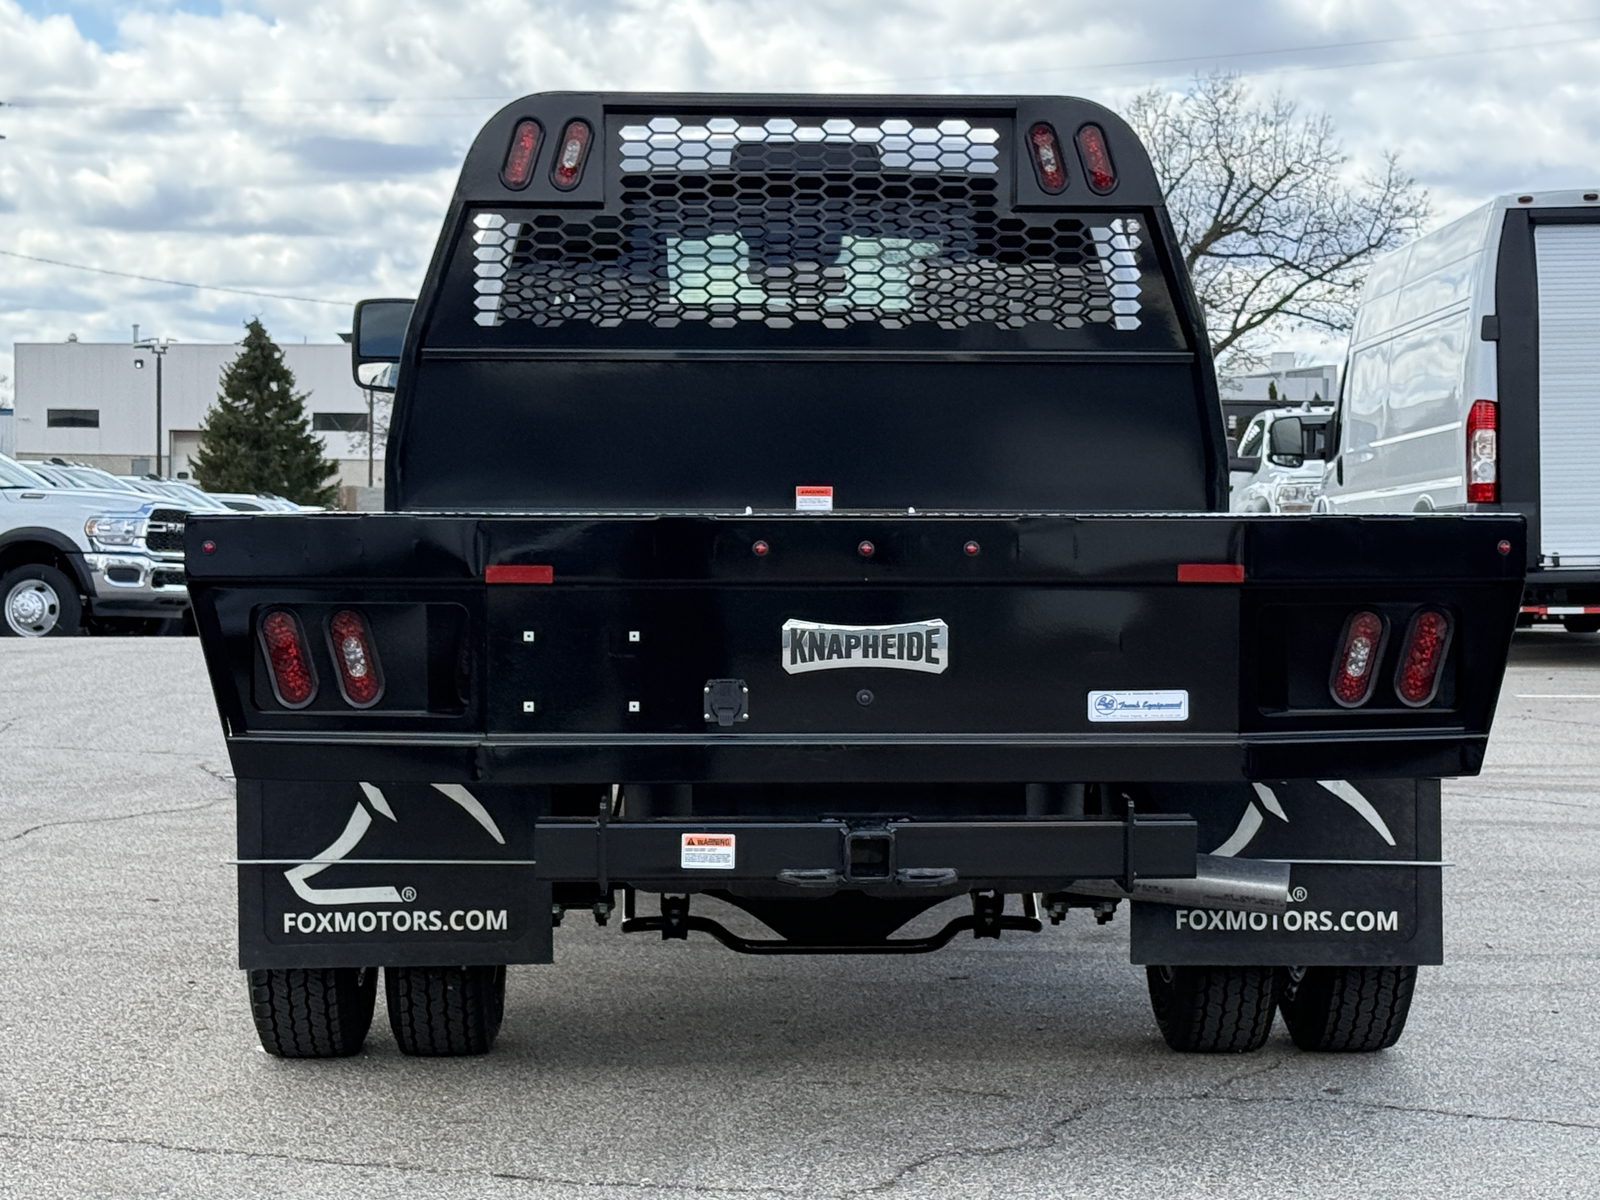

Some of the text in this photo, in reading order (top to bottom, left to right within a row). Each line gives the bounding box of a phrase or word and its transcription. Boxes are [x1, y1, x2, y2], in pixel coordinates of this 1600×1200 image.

[790, 627, 940, 666] KNAPHEIDE
[1142, 700, 1183, 711] Equipment
[697, 838, 730, 846] WARNING
[283, 909, 509, 934] FOXMOTORS.COM
[1175, 909, 1399, 932] FOXMOTORS.COM
